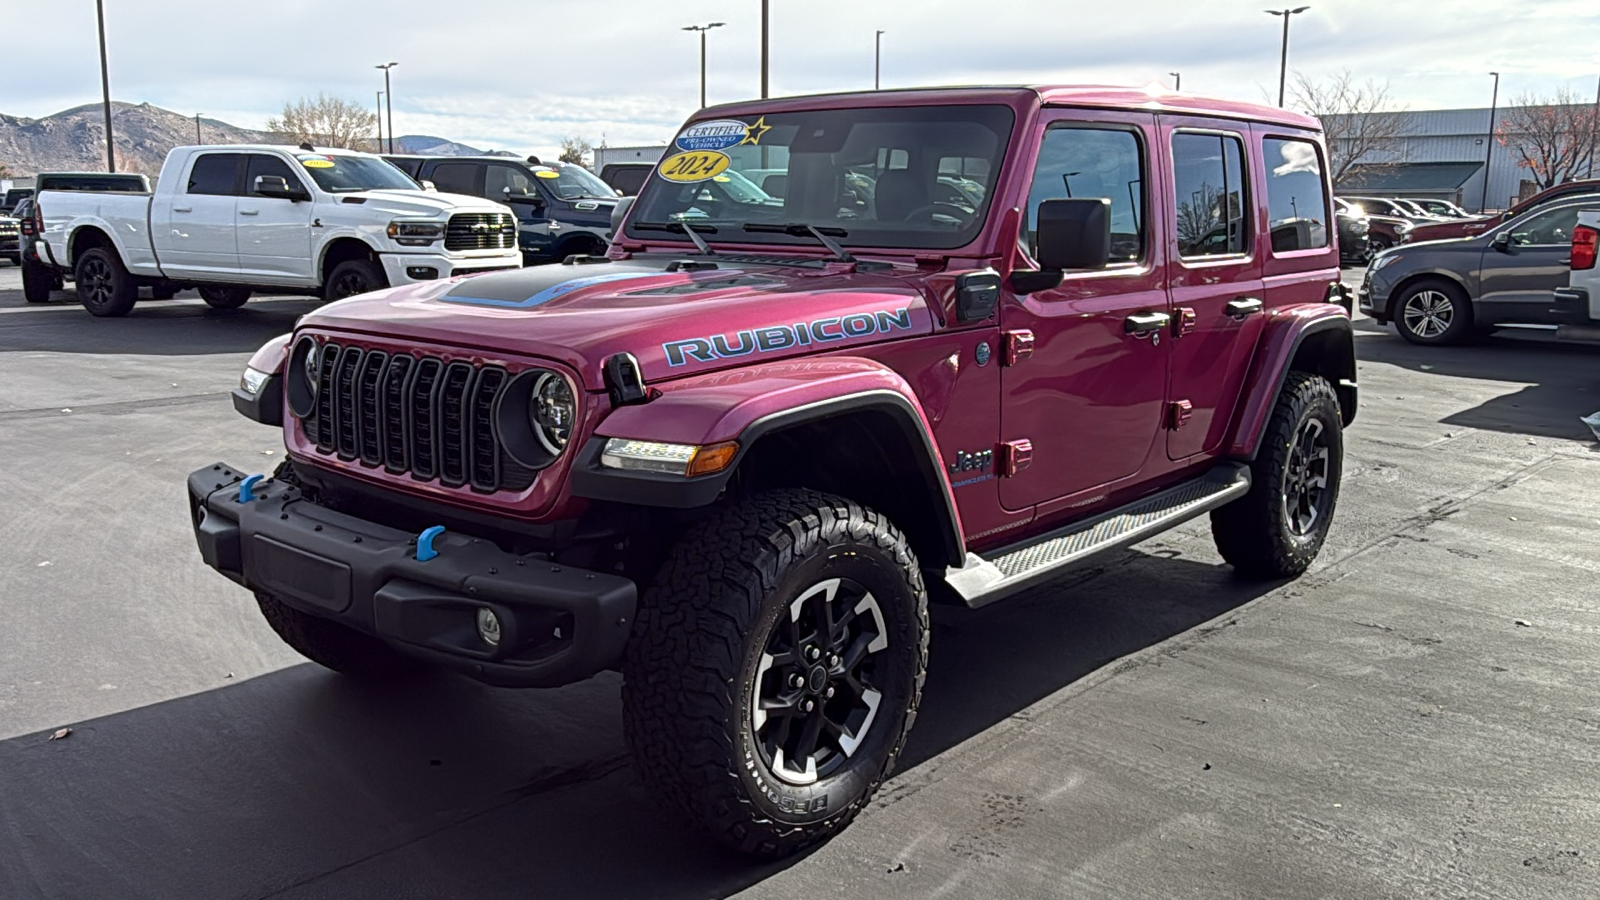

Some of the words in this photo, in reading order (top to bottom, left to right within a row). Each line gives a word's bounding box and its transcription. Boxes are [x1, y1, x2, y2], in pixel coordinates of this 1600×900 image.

[684, 136, 736, 144] PRE-OWNED
[686, 125, 745, 137] CERTIFIED
[664, 155, 724, 175] 2024
[662, 307, 912, 367] RUBICON
[949, 449, 993, 474] Jeep
